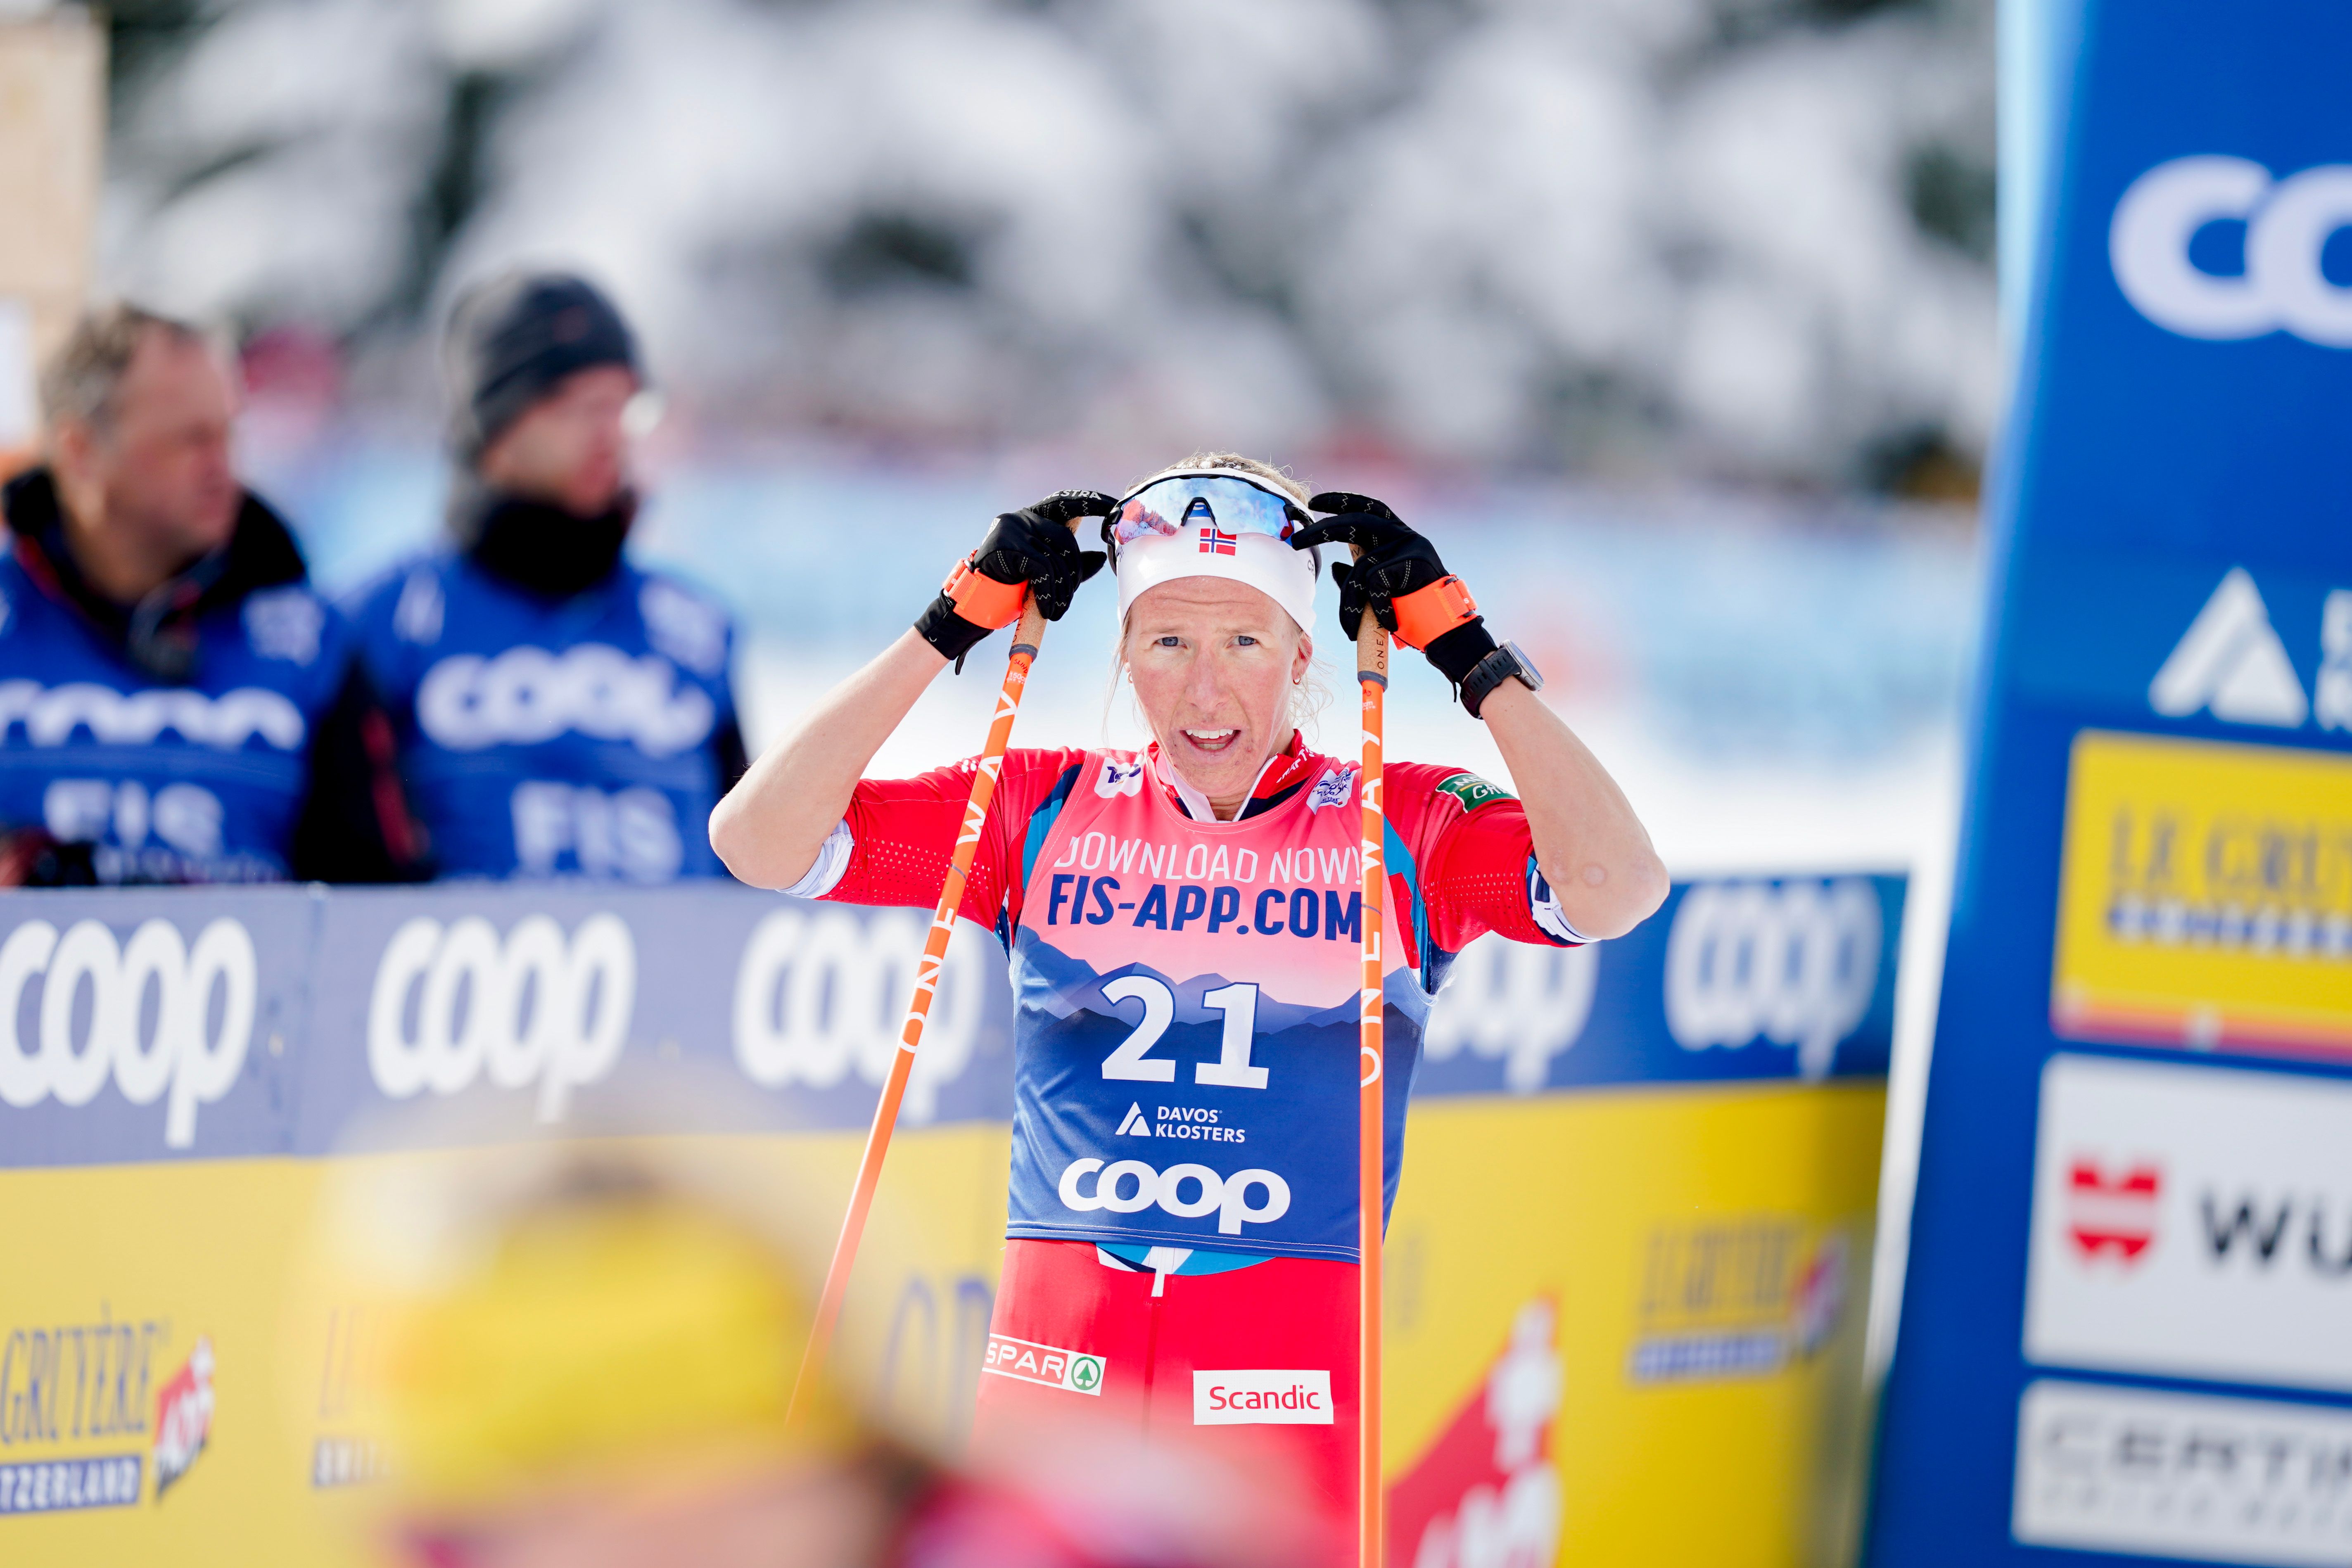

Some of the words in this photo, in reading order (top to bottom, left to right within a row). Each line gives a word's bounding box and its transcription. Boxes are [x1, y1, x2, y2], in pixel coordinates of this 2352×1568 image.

[1009, 671, 1026, 681] 150c
[1054, 831, 1258, 883] DOWNLOAD
[1268, 845, 1362, 885] NOW!
[1047, 873, 1362, 944] FIS-APP.COM
[0, 917, 258, 1149] coop
[367, 911, 637, 1124] coop
[1099, 974, 1270, 1089] 21
[1156, 1124, 1246, 1143] KLOSTERS
[1157, 1105, 1219, 1123] DAVOS
[1058, 1158, 1291, 1235] coop
[986, 1342, 1065, 1379] SPAR
[1209, 1384, 1321, 1411] Scandic
